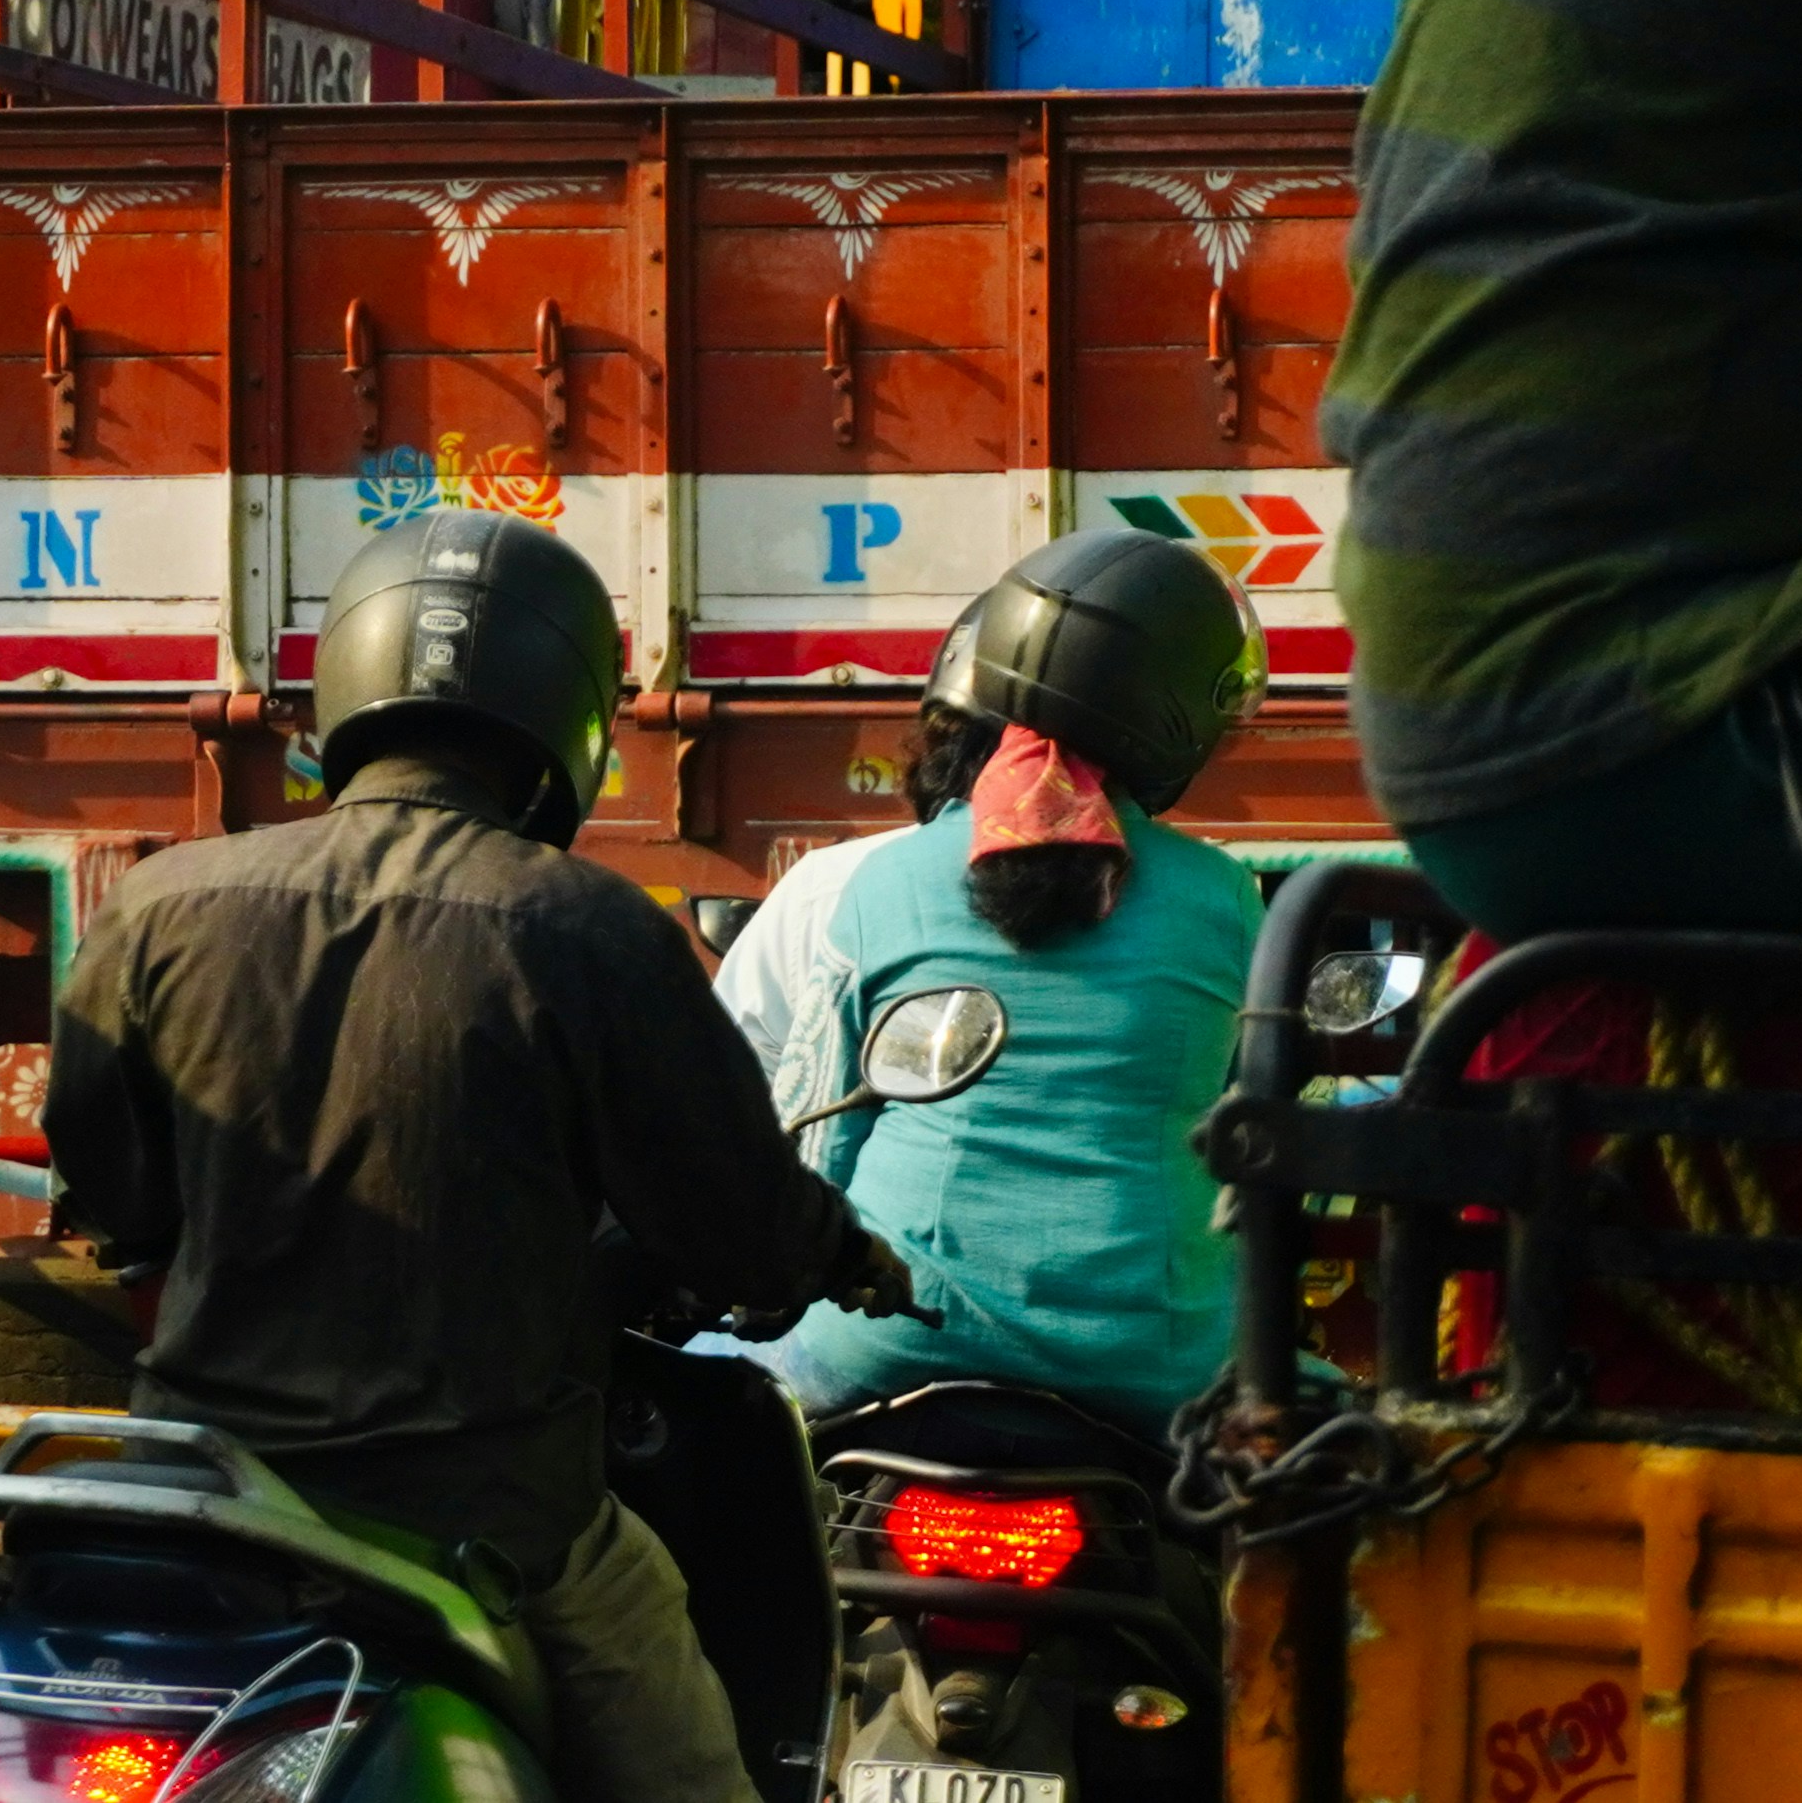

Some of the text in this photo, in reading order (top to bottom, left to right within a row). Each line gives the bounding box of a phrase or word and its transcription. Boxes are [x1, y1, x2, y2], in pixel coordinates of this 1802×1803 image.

[268, 17, 354, 103] BAGS
[19, 503, 902, 589] N P
[1485, 1680, 1630, 1803] STOP
